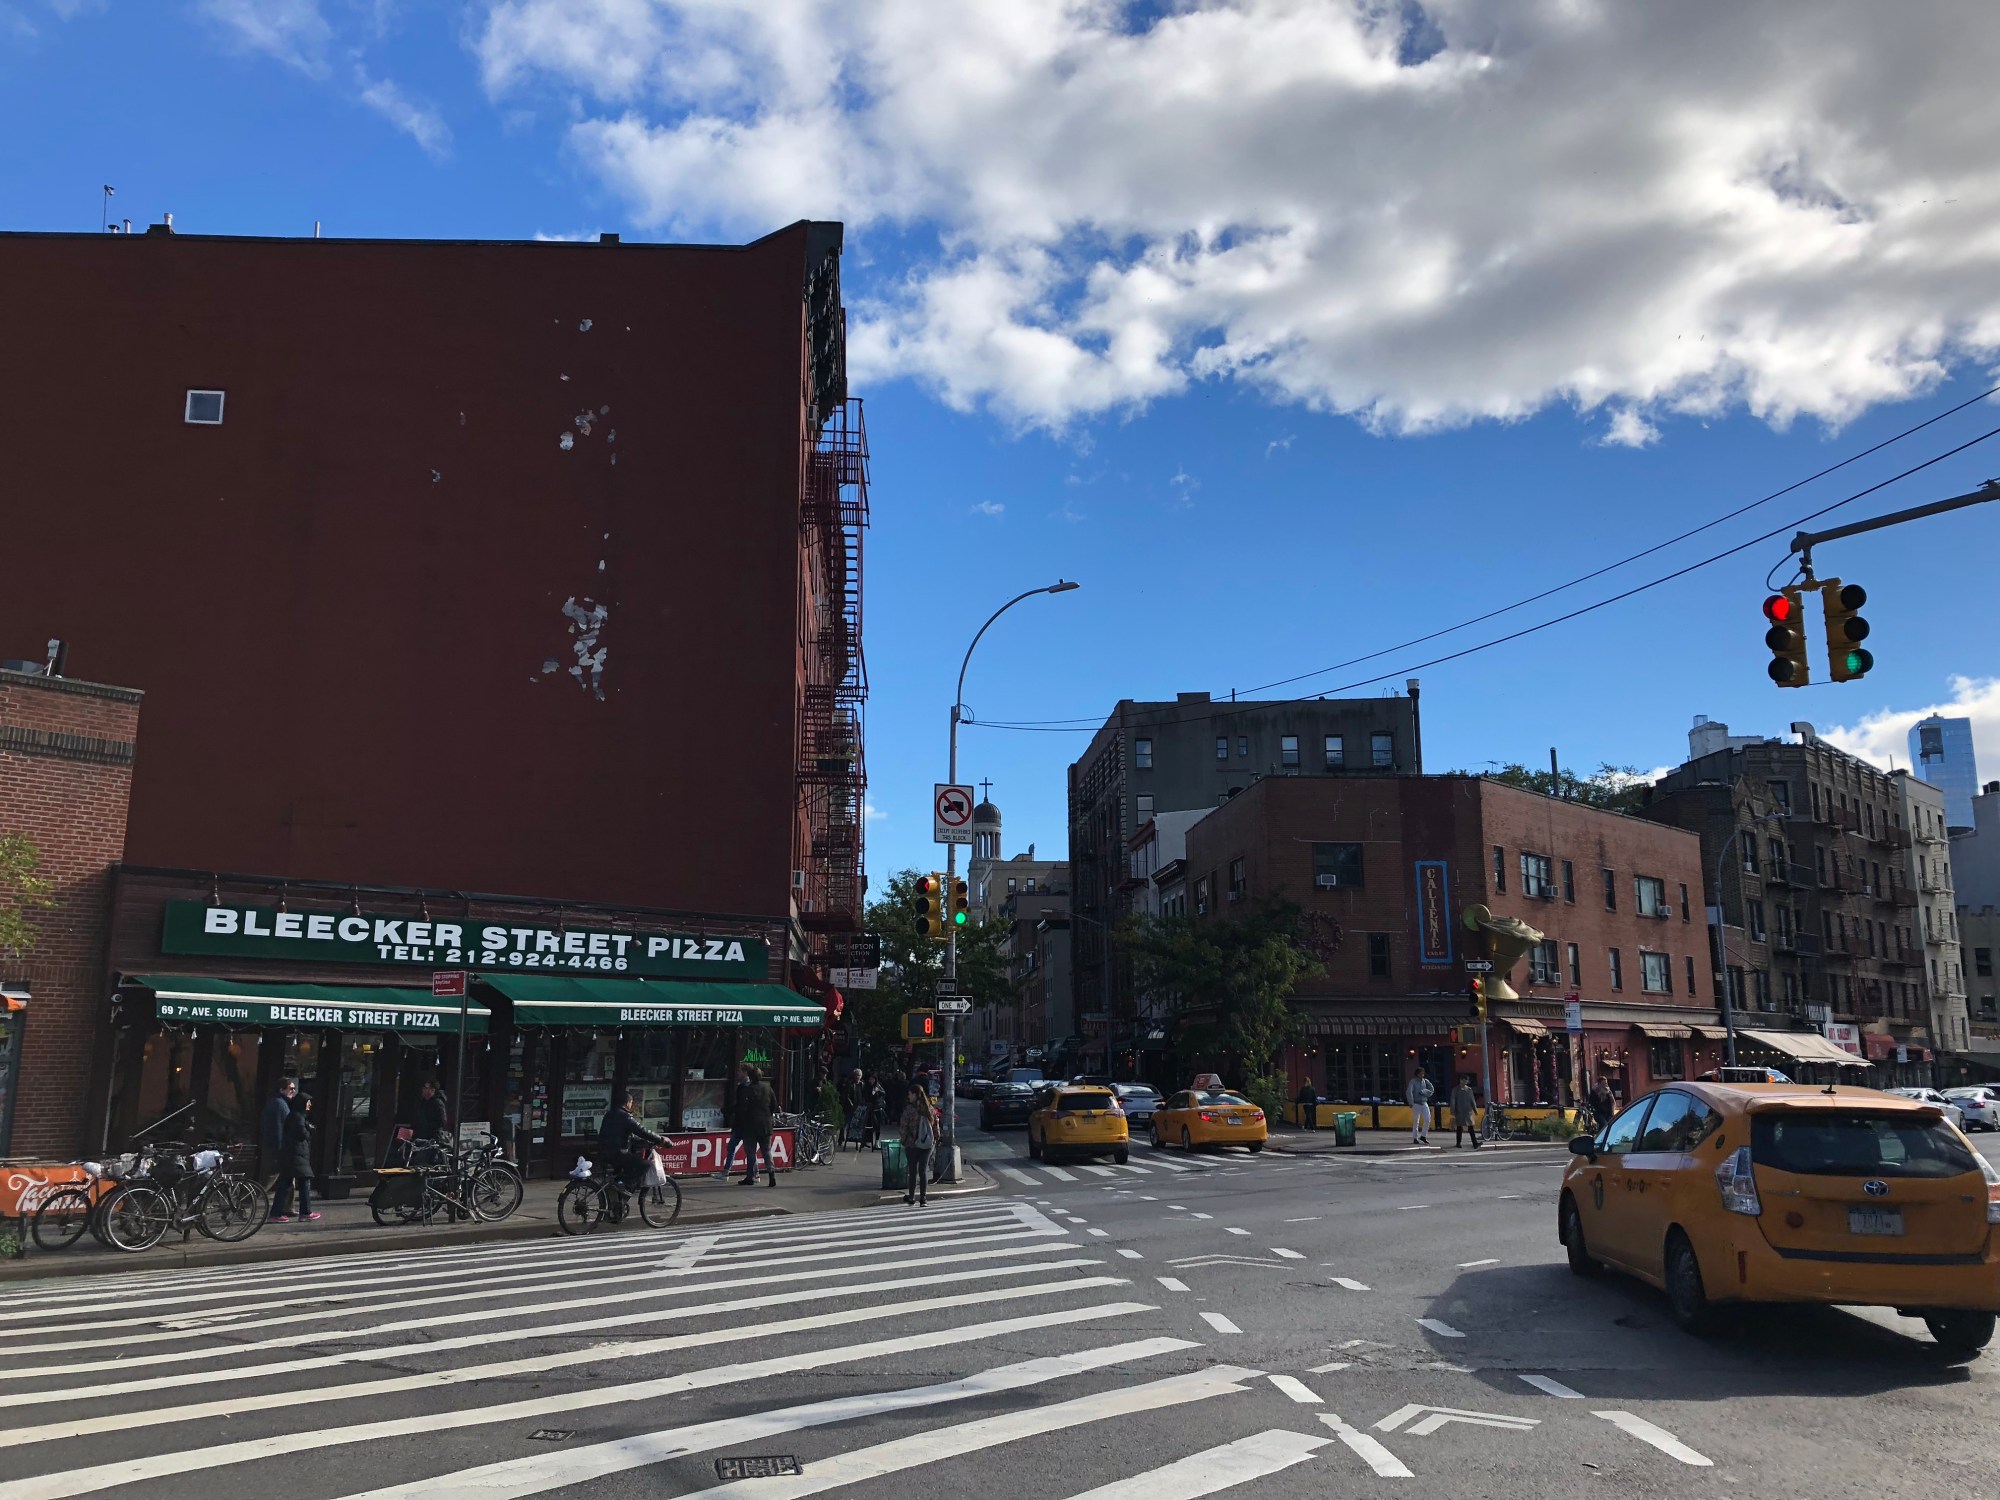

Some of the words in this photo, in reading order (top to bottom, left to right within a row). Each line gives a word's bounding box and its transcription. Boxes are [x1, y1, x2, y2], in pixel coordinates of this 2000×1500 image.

[1426, 868, 1441, 950] CALIENTE
[204, 908, 463, 947] BLEECKER
[481, 926, 632, 956] STREET
[647, 936, 745, 962] PIZZA
[377, 944, 435, 962] TEL:
[445, 949, 628, 971] 212-924-4466
[161, 1005, 174, 1015] 69
[191, 1007, 213, 1017] AVE.
[216, 1008, 249, 1018] SOUTH
[270, 1006, 343, 1023] BLEECKER
[349, 1010, 398, 1025] STREET
[403, 1013, 440, 1027] PIZZA
[620, 1009, 673, 1021] BLEECKER
[677, 1010, 713, 1022] STREET
[716, 1010, 743, 1022] PIZZA
[773, 1015, 781, 1023] 69
[803, 1015, 820, 1023] SOUTH
[1732, 1069, 1758, 1081] 7C71
